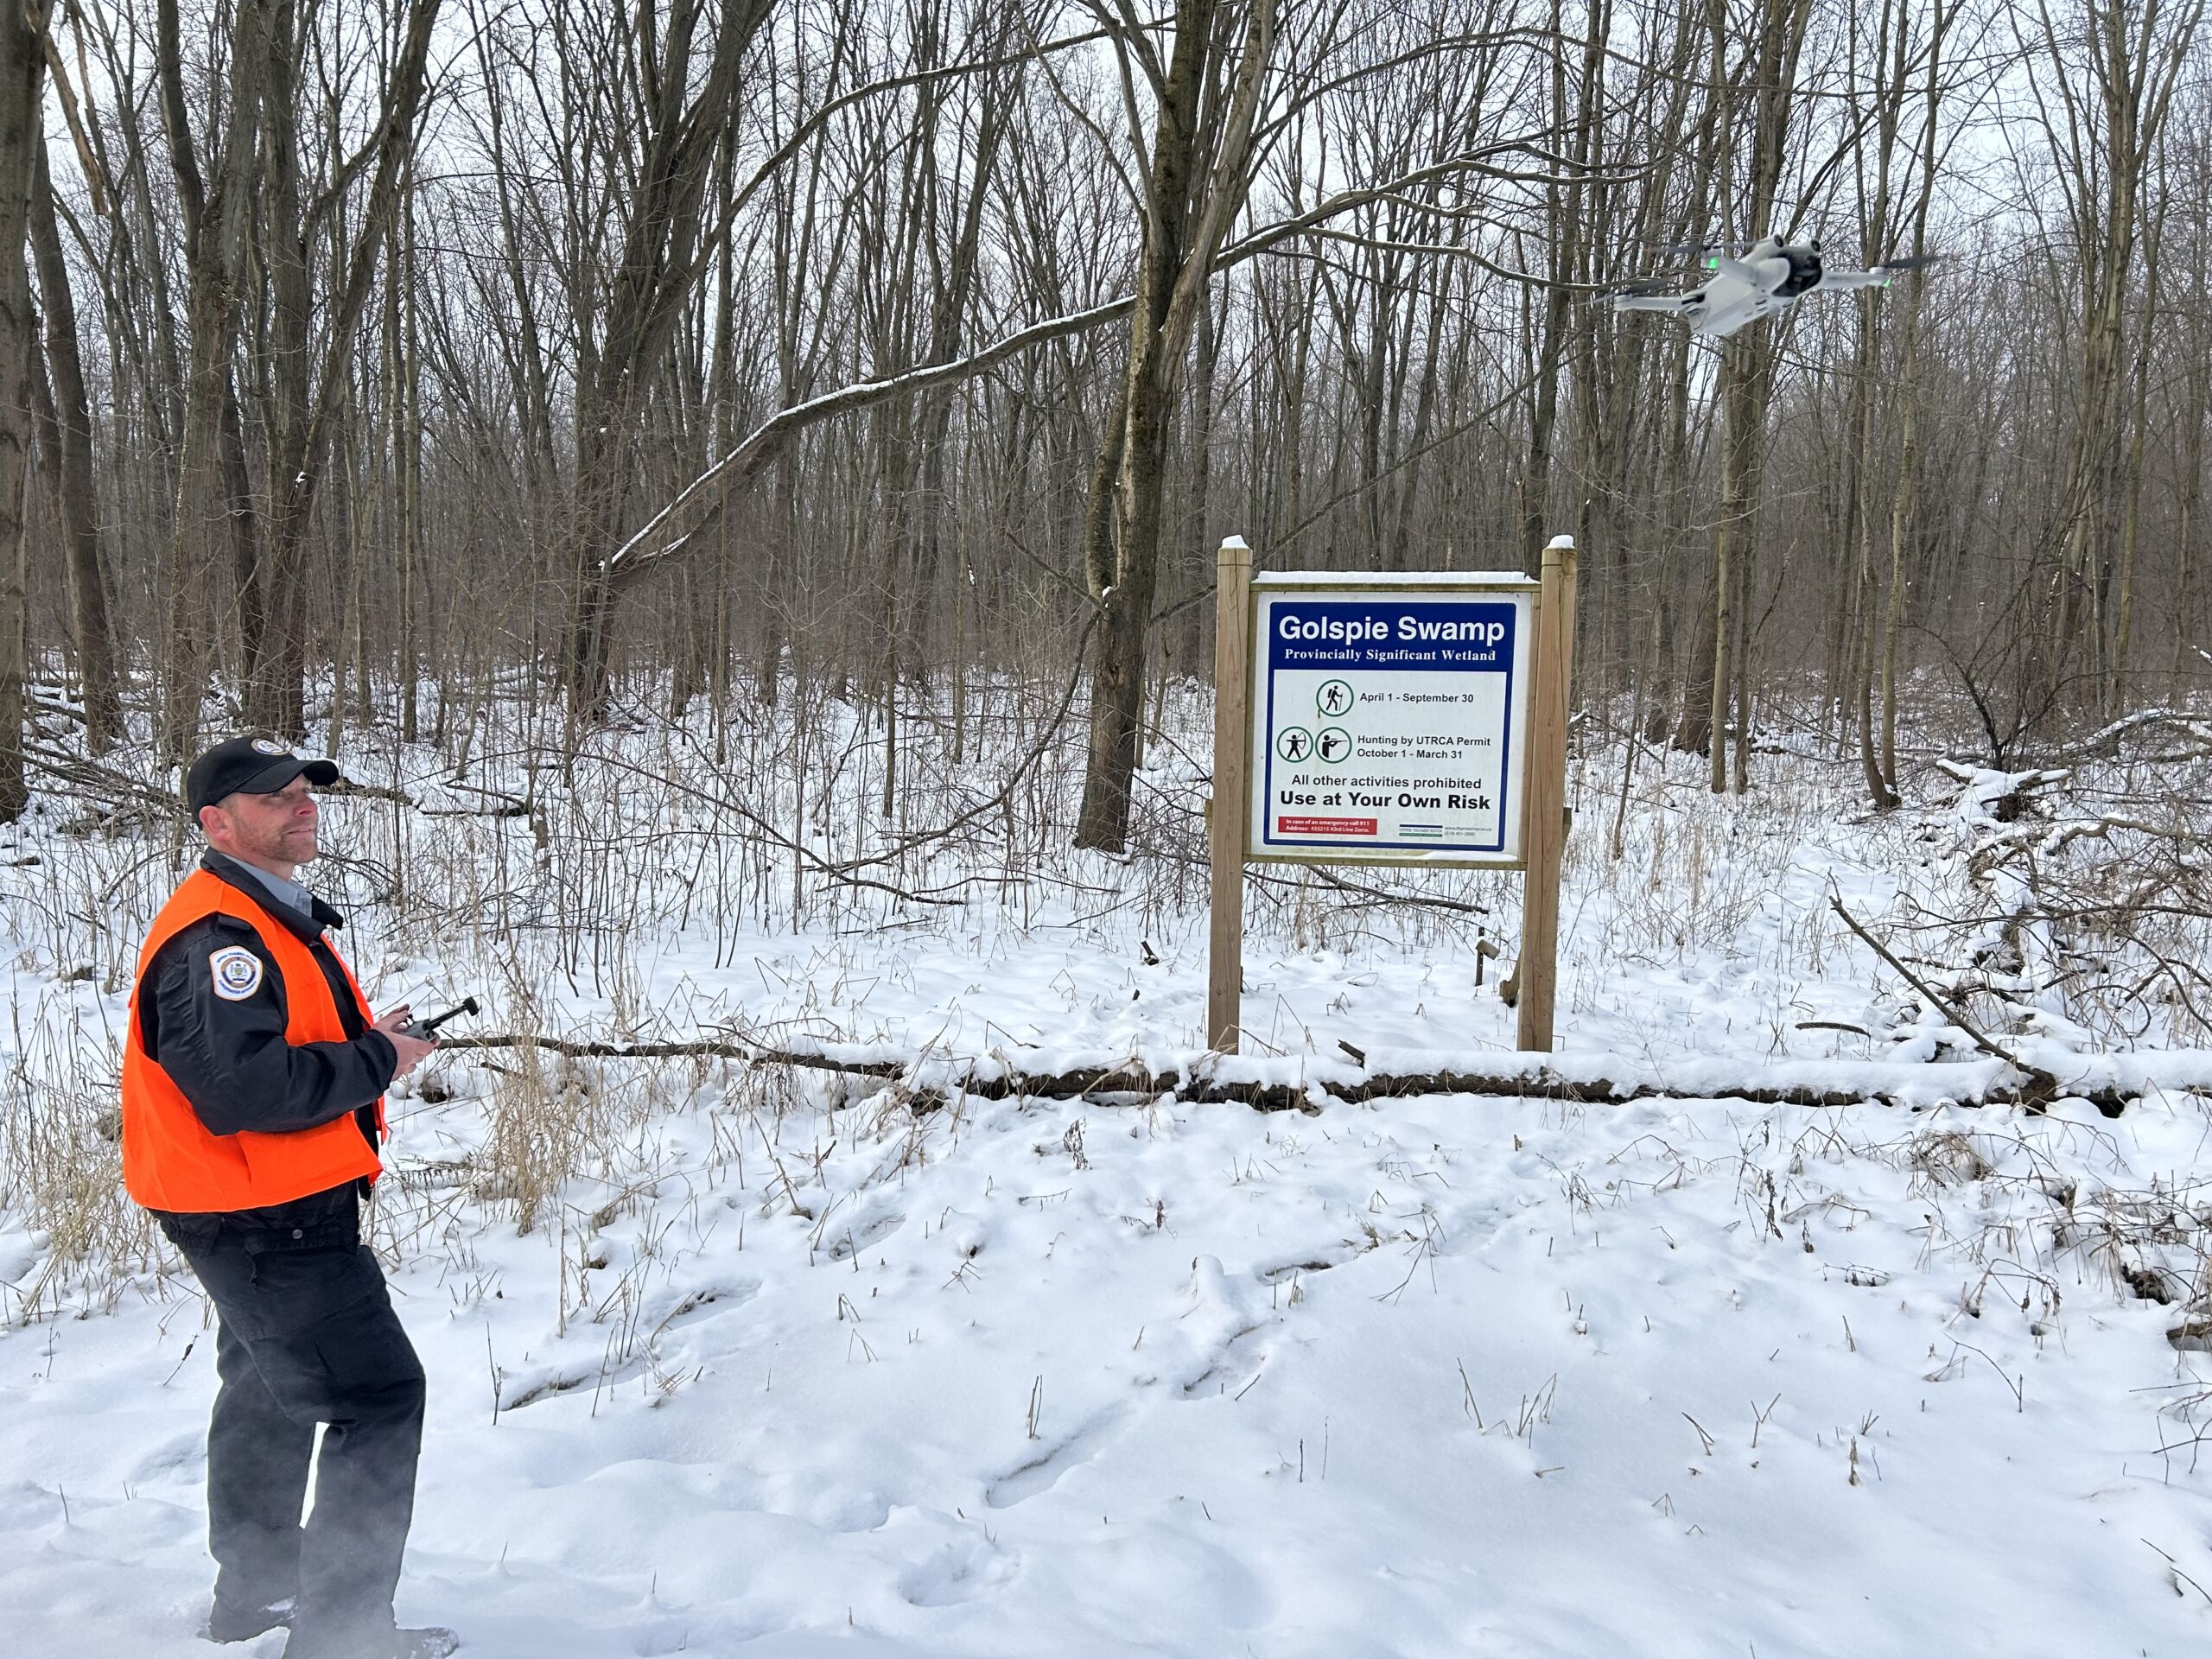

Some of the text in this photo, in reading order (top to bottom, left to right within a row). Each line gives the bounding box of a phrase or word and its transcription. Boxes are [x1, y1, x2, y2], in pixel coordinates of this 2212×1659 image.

[1279, 616, 1504, 646] Golspie Swamp
[1285, 649, 1496, 661] Provincially Significant Wetland
[1360, 693, 1384, 704] April
[1403, 694, 1459, 705] September
[1461, 694, 1473, 702] 30
[1358, 735, 1491, 747] Hunting by UTRCA Permit
[1357, 749, 1398, 758] October
[1402, 749, 1406, 758] 1
[1416, 750, 1448, 759] March
[1451, 750, 1462, 759] 31
[1292, 775, 1481, 789] All other activities prohibited
[1281, 791, 1491, 809] Use at Your Own Risk
